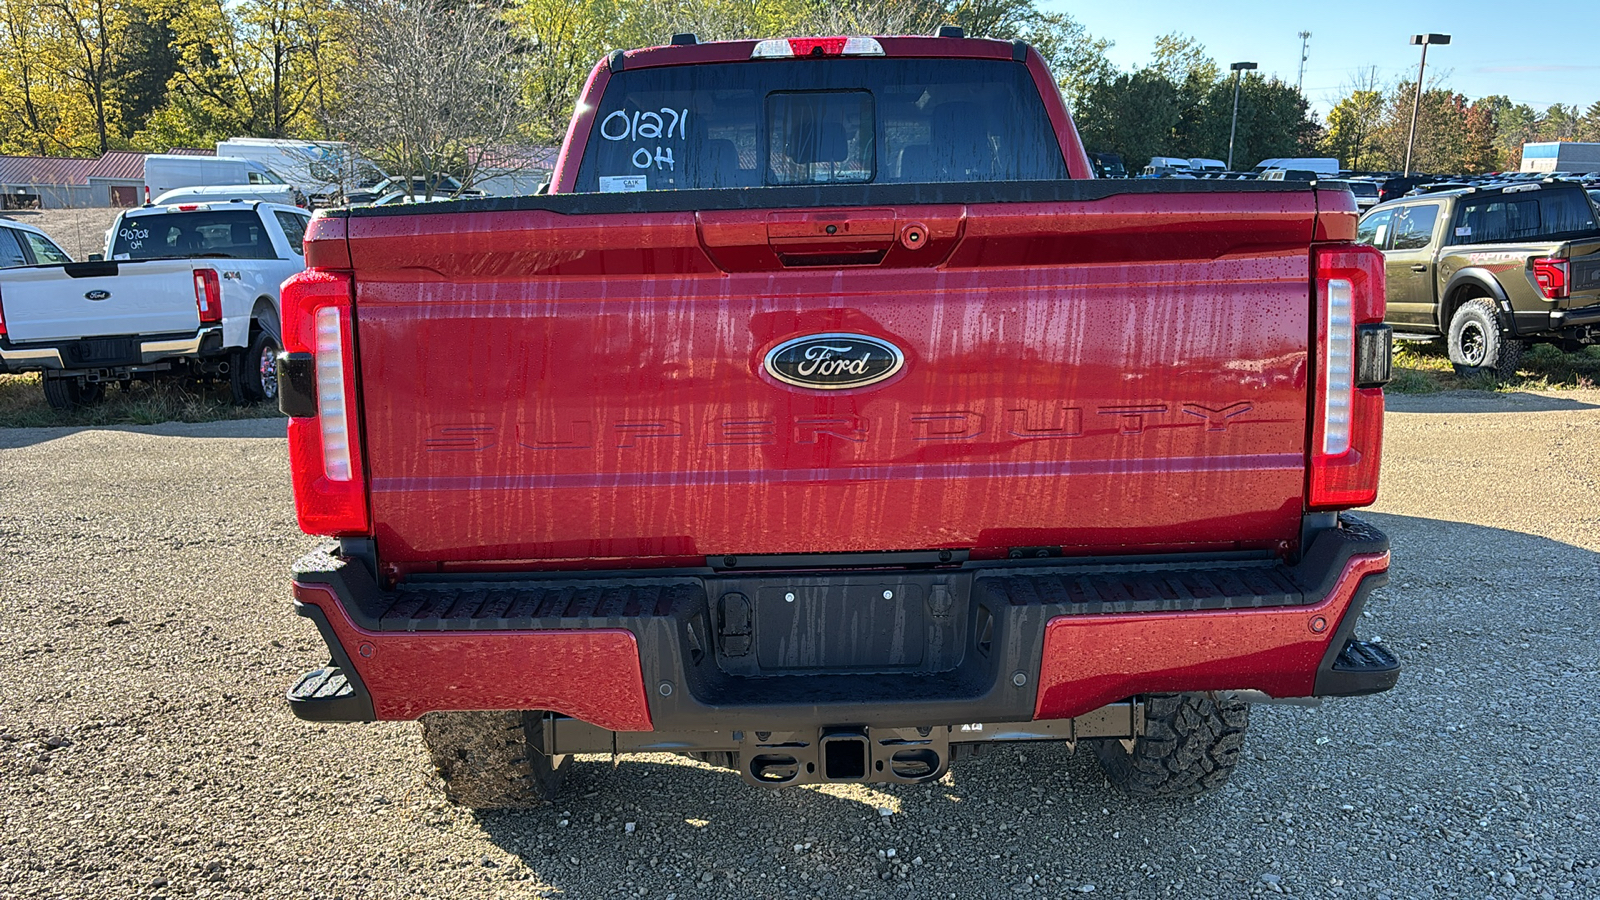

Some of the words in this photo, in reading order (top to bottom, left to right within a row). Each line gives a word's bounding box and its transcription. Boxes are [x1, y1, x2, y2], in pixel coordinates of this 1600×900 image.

[600, 107, 688, 141] 01271
[632, 146, 675, 171] OH
[119, 228, 149, 241] 90708
[130, 240, 143, 250] OH
[1468, 252, 1525, 264] RAPTOR
[90, 291, 106, 299] Ford
[797, 345, 871, 376] Ford
[425, 414, 871, 452] SUPER
[911, 402, 1252, 441] DUTY
